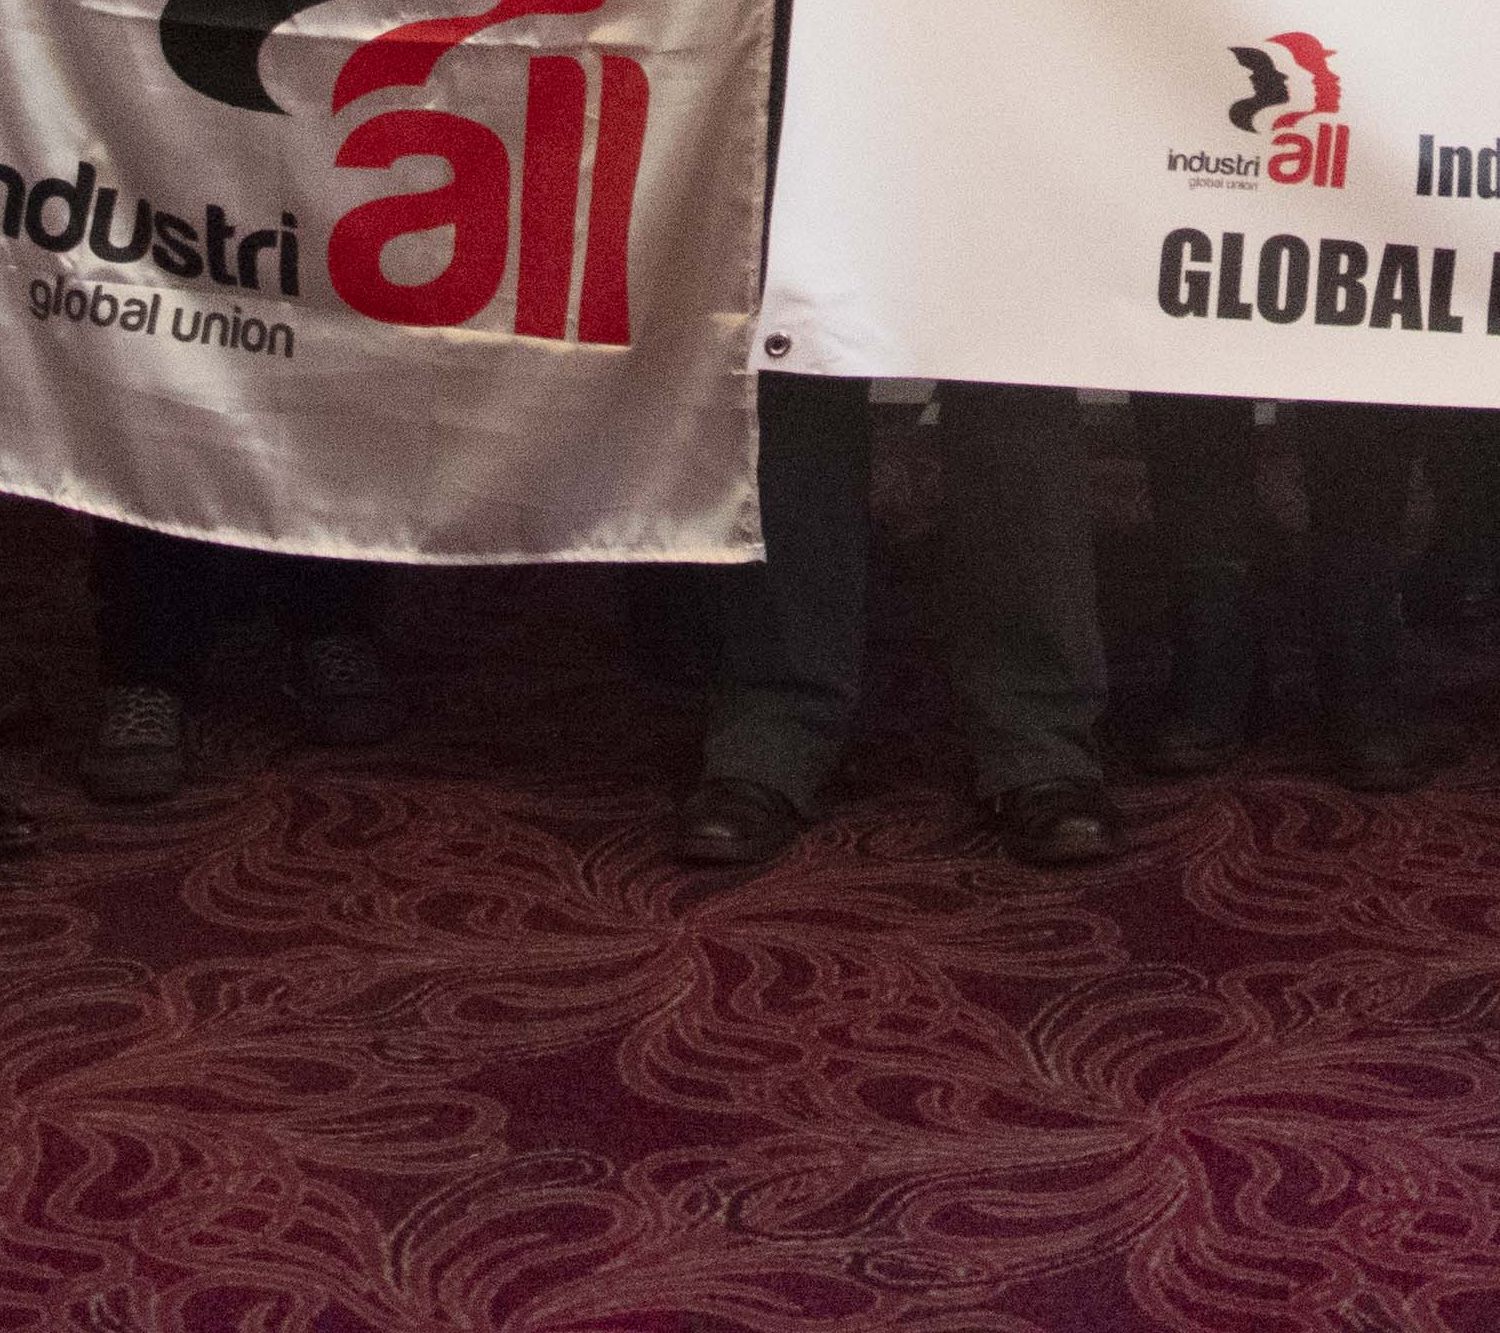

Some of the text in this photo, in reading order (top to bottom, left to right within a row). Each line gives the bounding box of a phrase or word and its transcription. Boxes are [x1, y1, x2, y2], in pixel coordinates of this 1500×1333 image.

[29, 274, 295, 358] global union
[1158, 227, 1463, 333] GLOBAL
